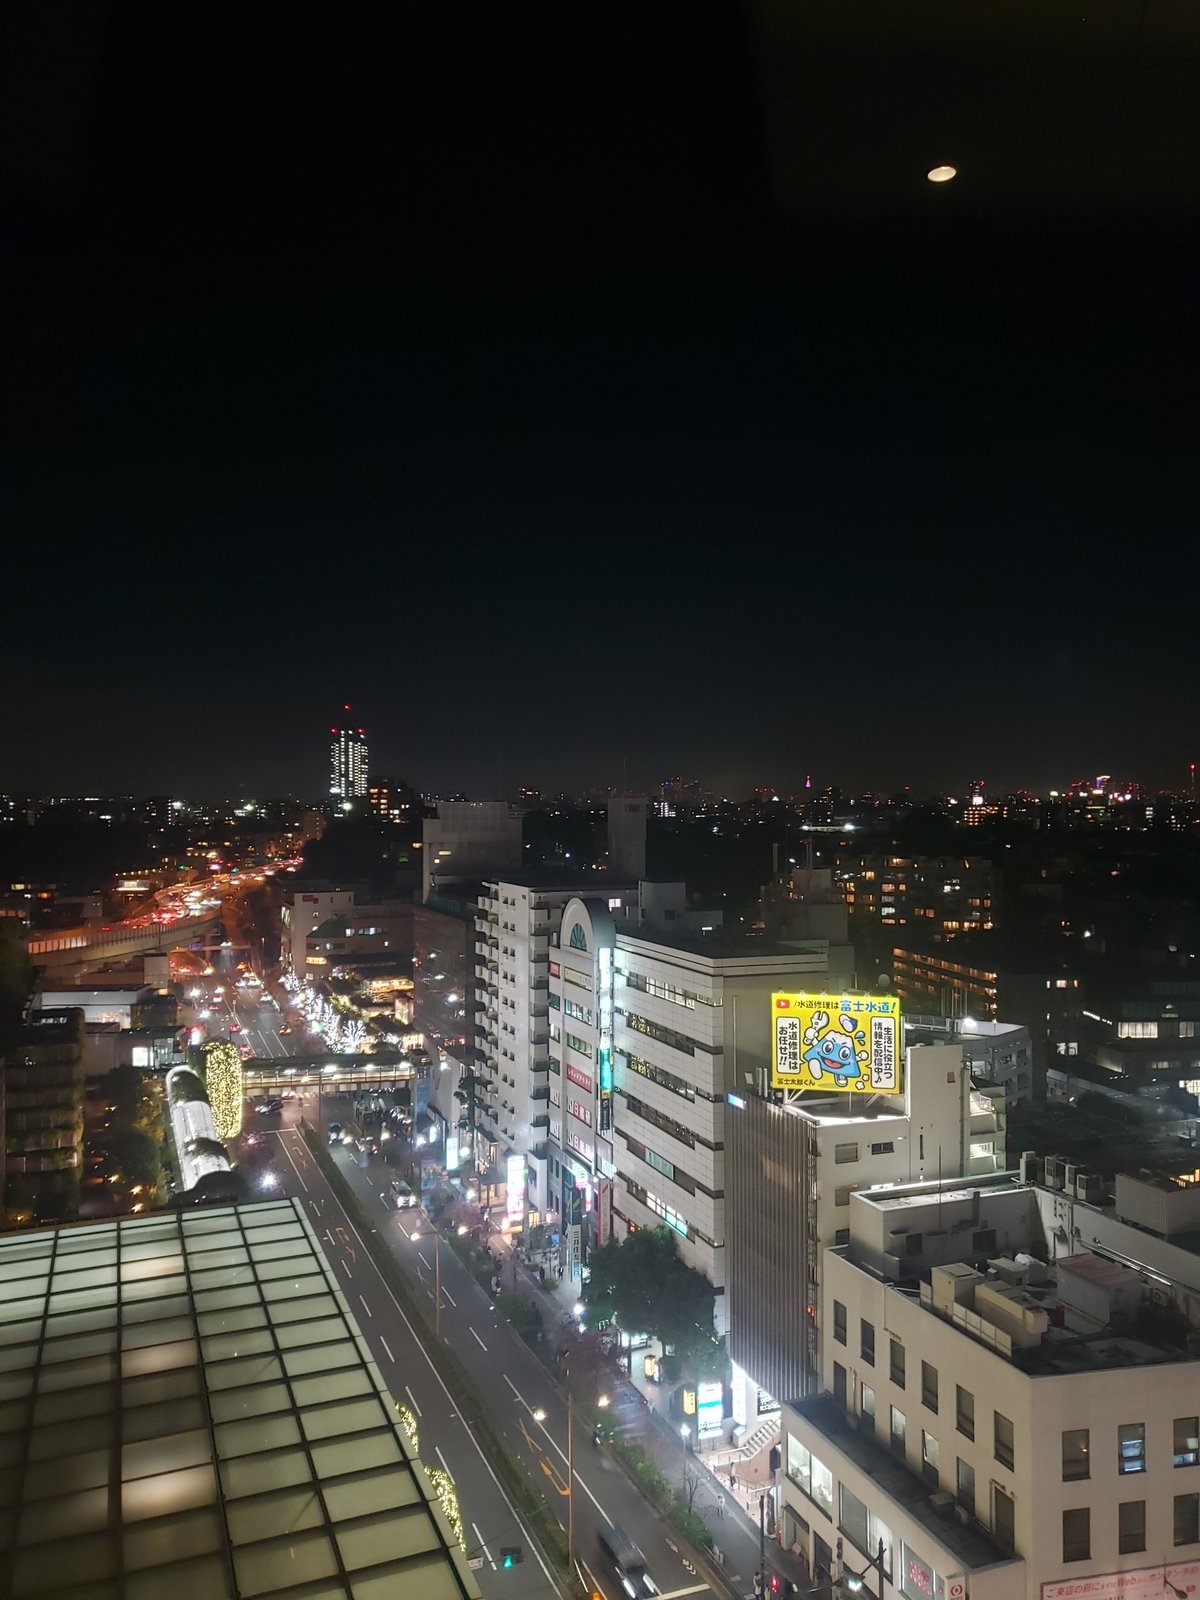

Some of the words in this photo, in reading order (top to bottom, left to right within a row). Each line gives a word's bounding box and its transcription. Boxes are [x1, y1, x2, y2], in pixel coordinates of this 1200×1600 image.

[788, 1021, 798, 1070] 水道修理は
[883, 1027, 893, 1079] 生活に役立つ
